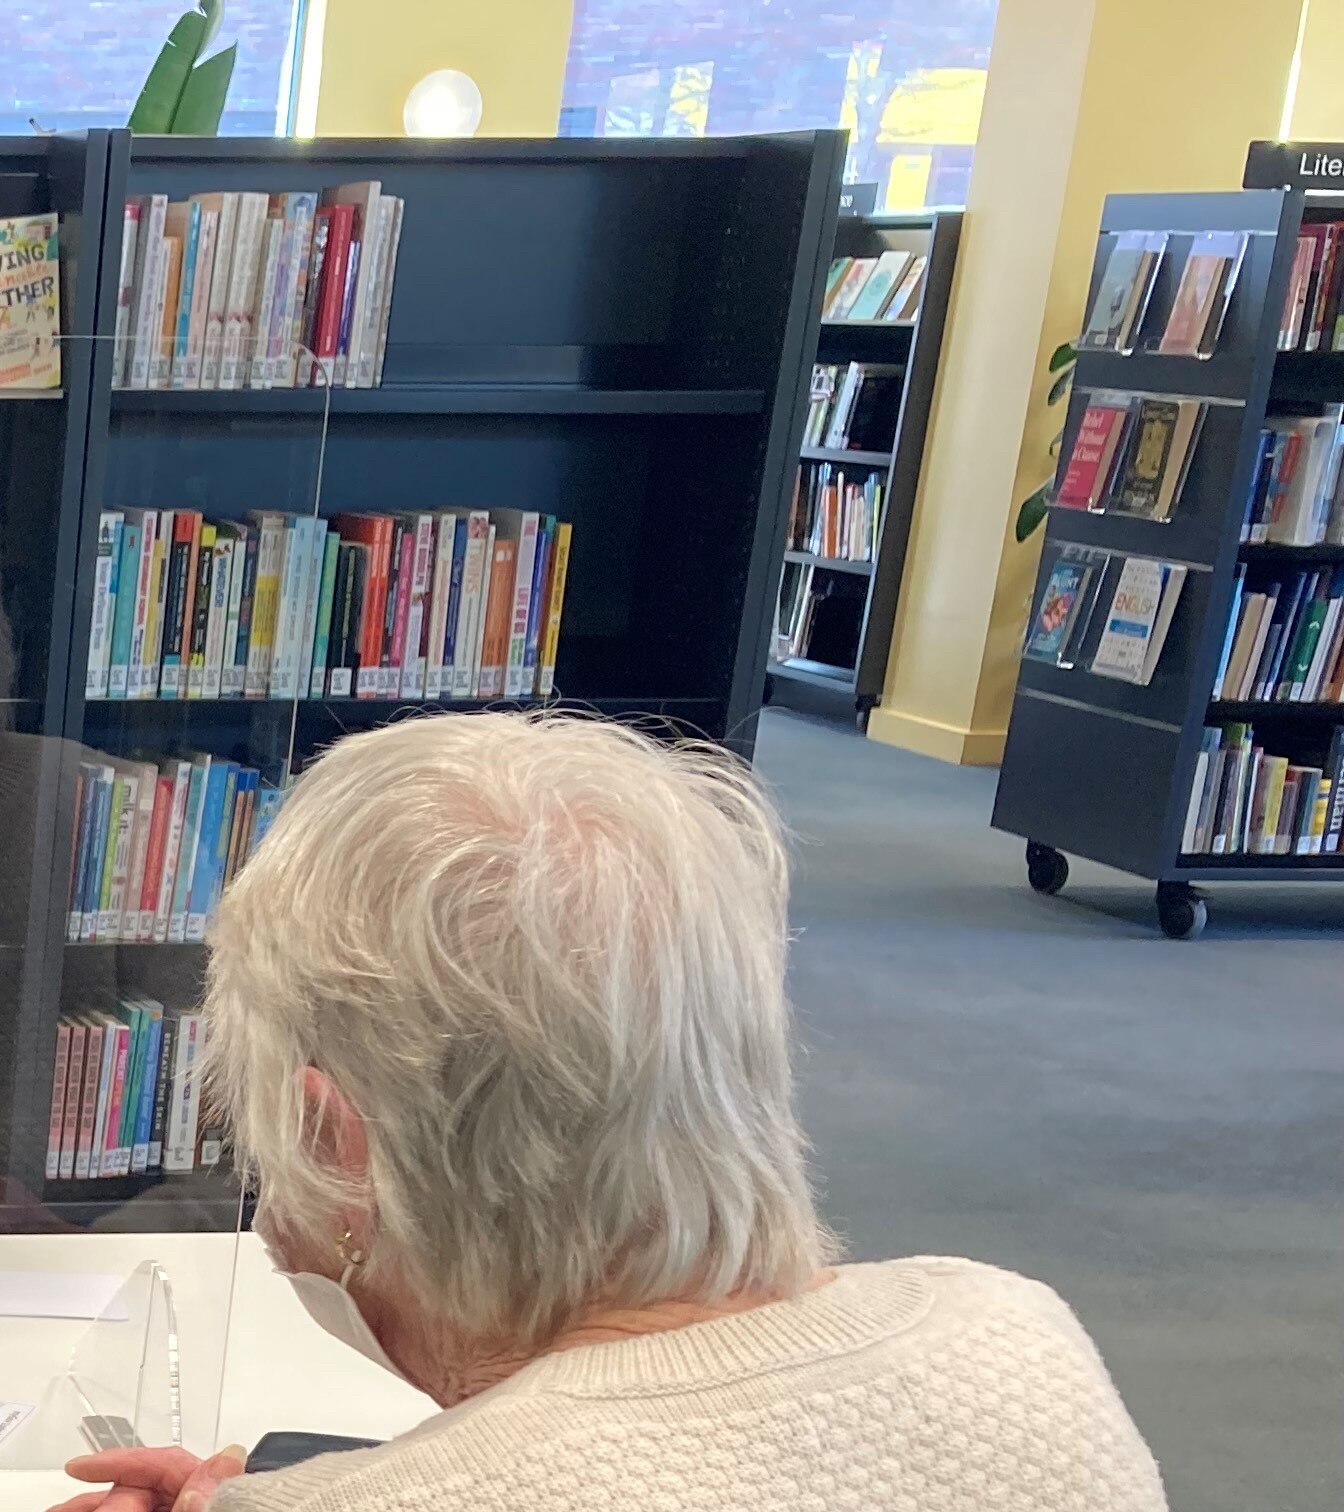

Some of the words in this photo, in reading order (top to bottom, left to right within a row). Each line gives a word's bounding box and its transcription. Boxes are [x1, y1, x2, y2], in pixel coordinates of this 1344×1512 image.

[1300, 153, 1344, 176] Lite
[466, 541, 483, 593] TWINS
[1115, 592, 1154, 615] ENGLISH
[120, 785, 133, 815] milk
[160, 1033, 171, 1079] BENEATH
[157, 1083, 166, 1102] THE
[155, 1107, 163, 1130] SKIN
